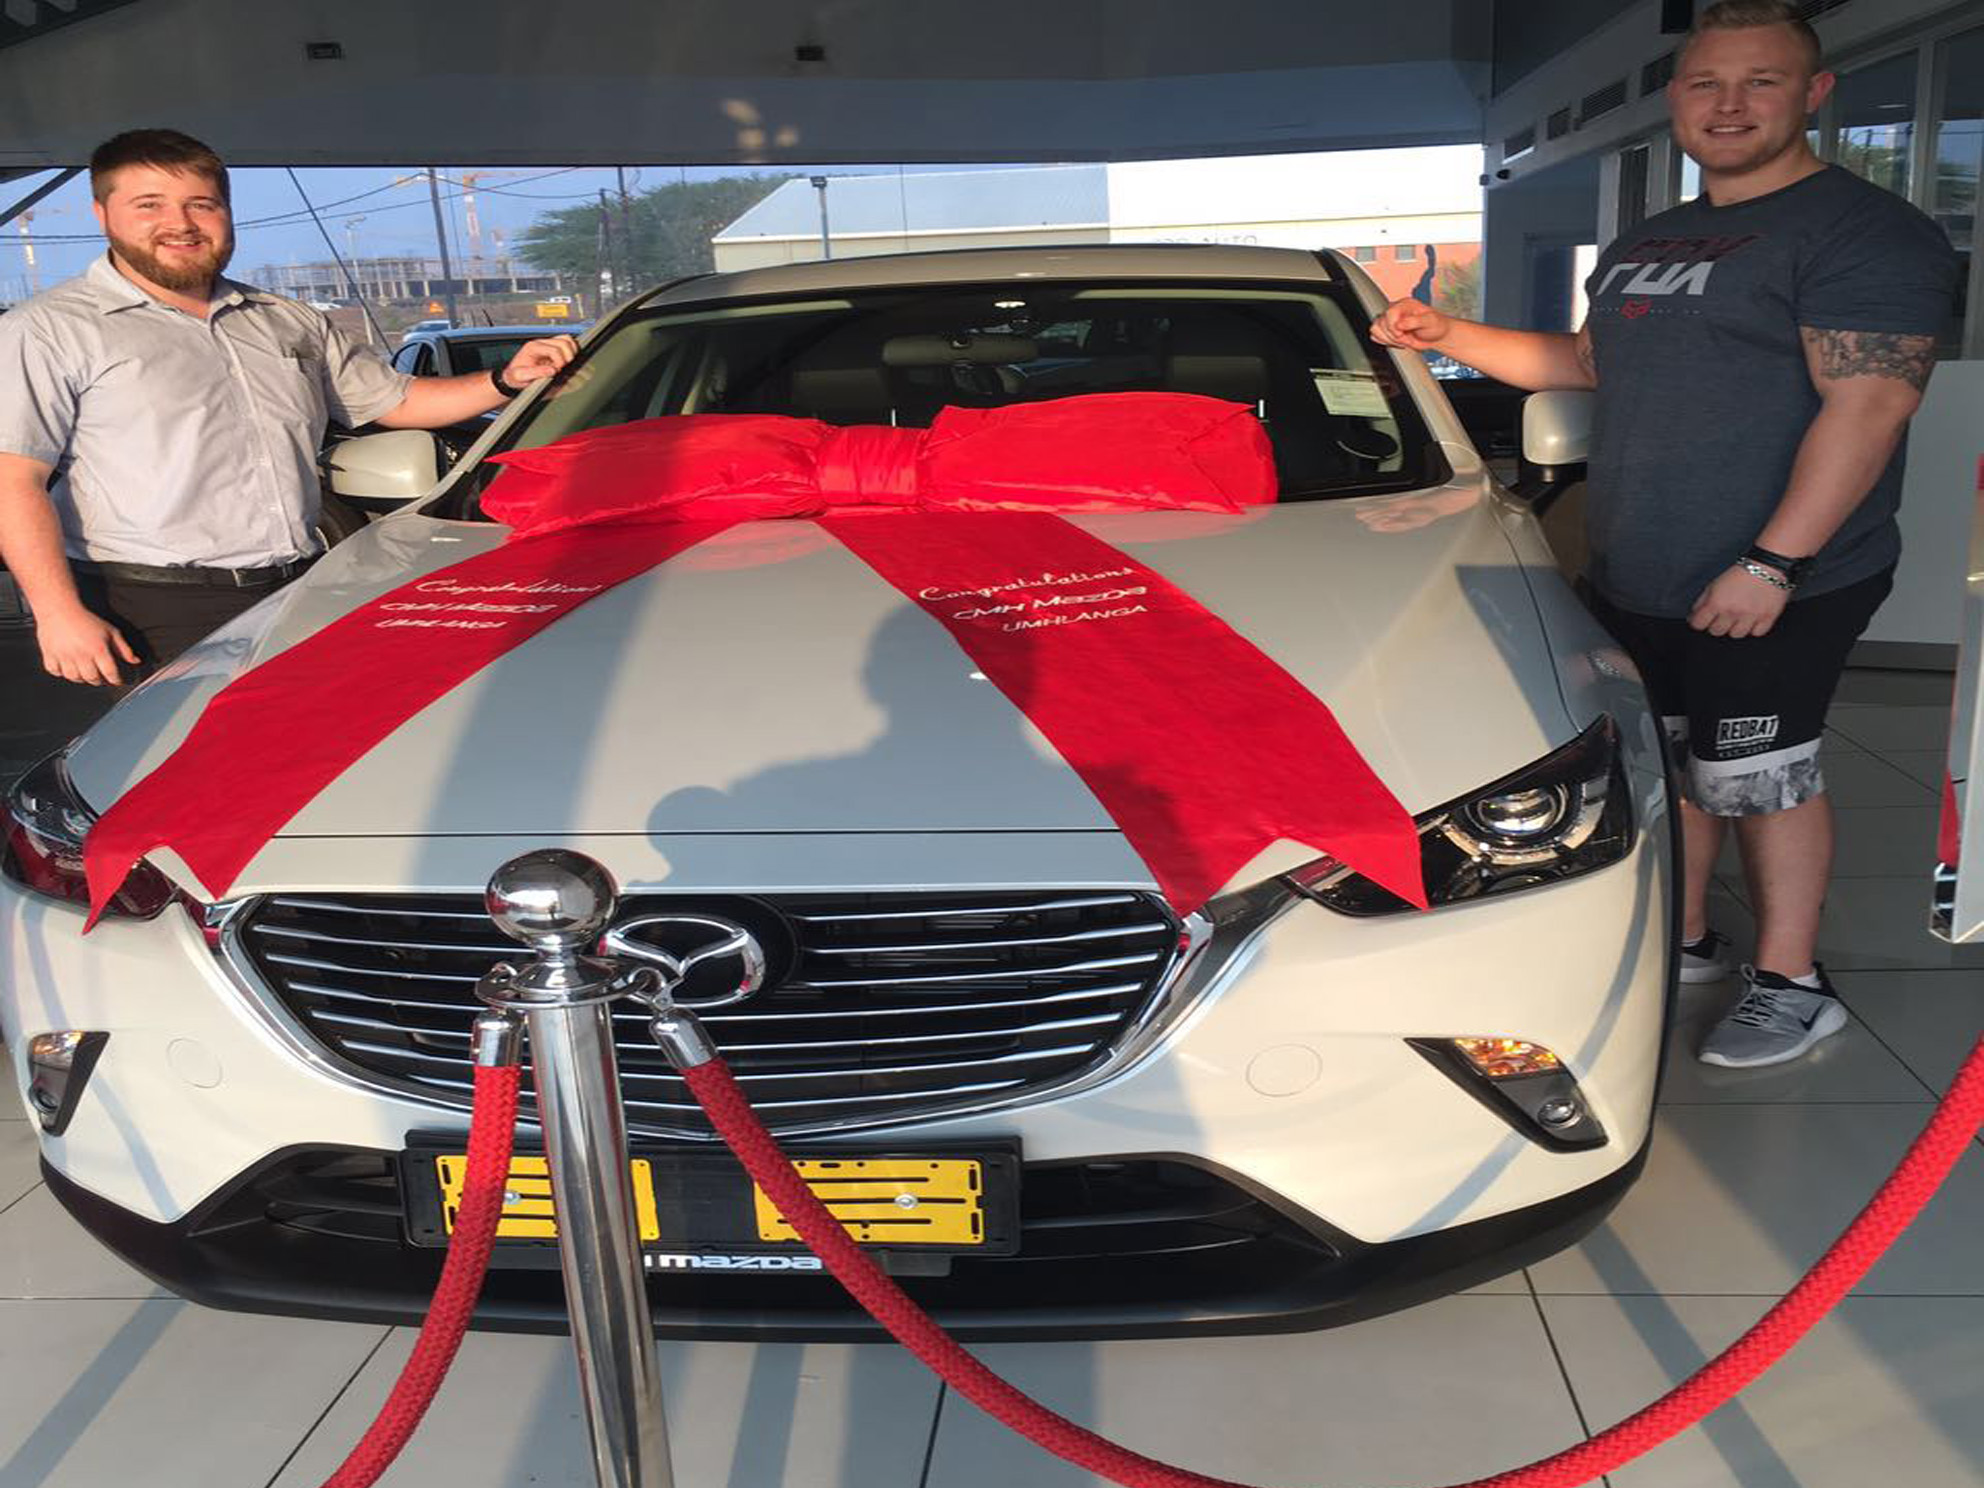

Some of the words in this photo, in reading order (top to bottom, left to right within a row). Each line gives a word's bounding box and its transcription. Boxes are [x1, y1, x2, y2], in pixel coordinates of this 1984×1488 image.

[919, 567, 1133, 600] Congratulations
[952, 603, 1025, 619] CMH
[1003, 605, 1147, 632] UMHLANGA
[1720, 718, 1777, 742] REDBAT
